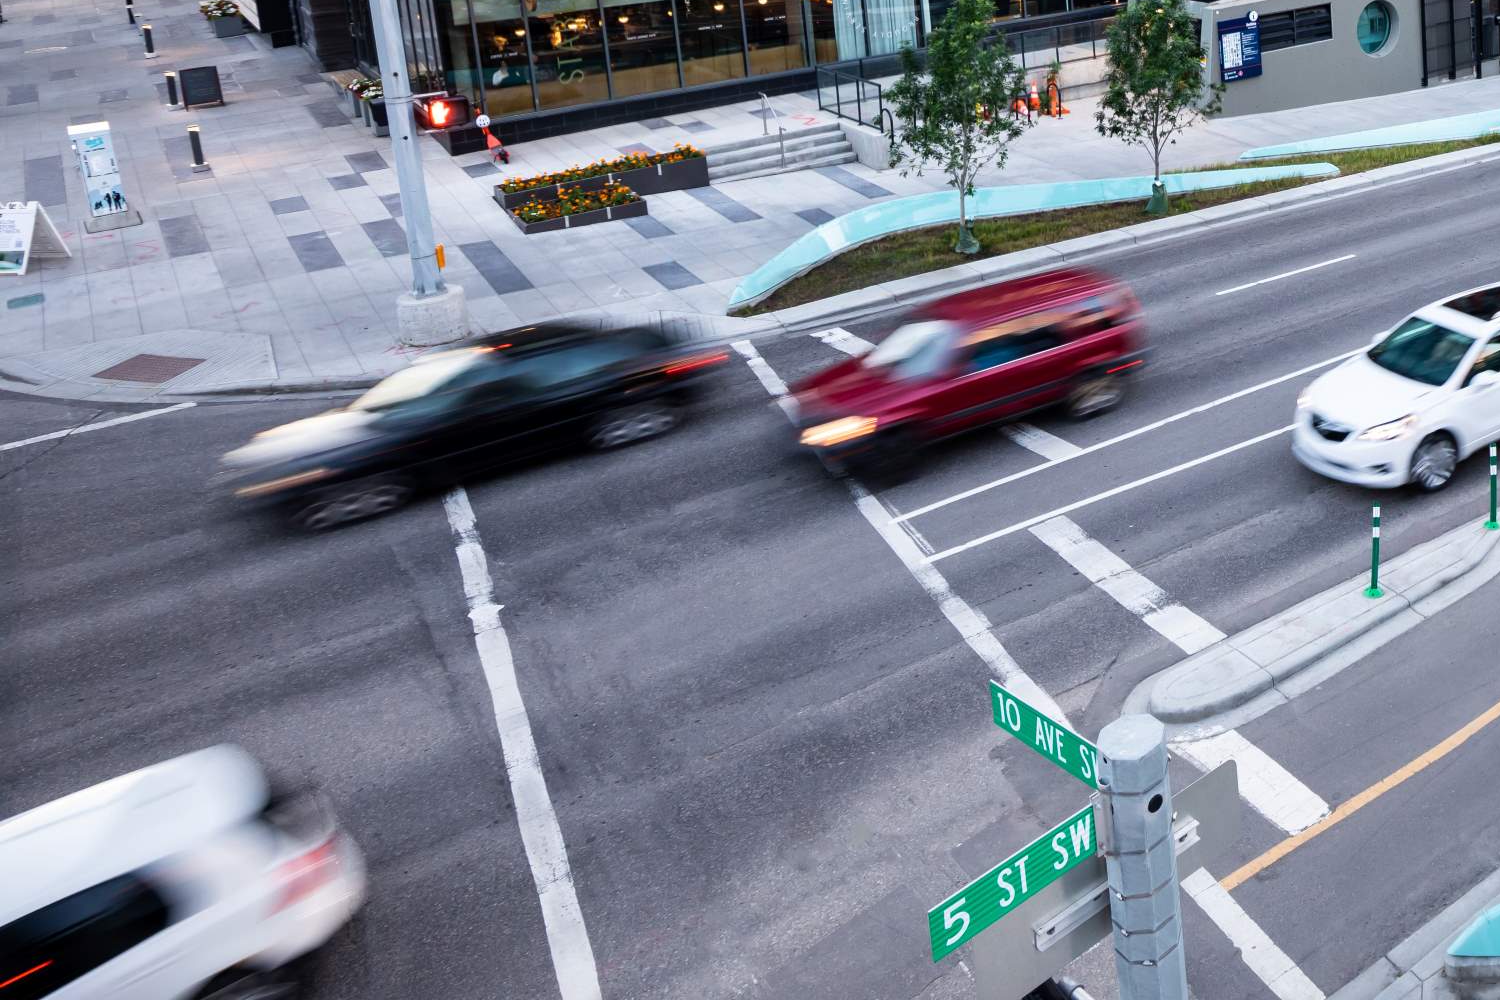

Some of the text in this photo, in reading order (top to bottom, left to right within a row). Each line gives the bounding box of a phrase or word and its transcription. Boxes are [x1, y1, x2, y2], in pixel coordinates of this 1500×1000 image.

[998, 692, 1021, 731] 10
[1035, 717, 1067, 764] AVE
[943, 815, 1092, 947] 5 ST SW
